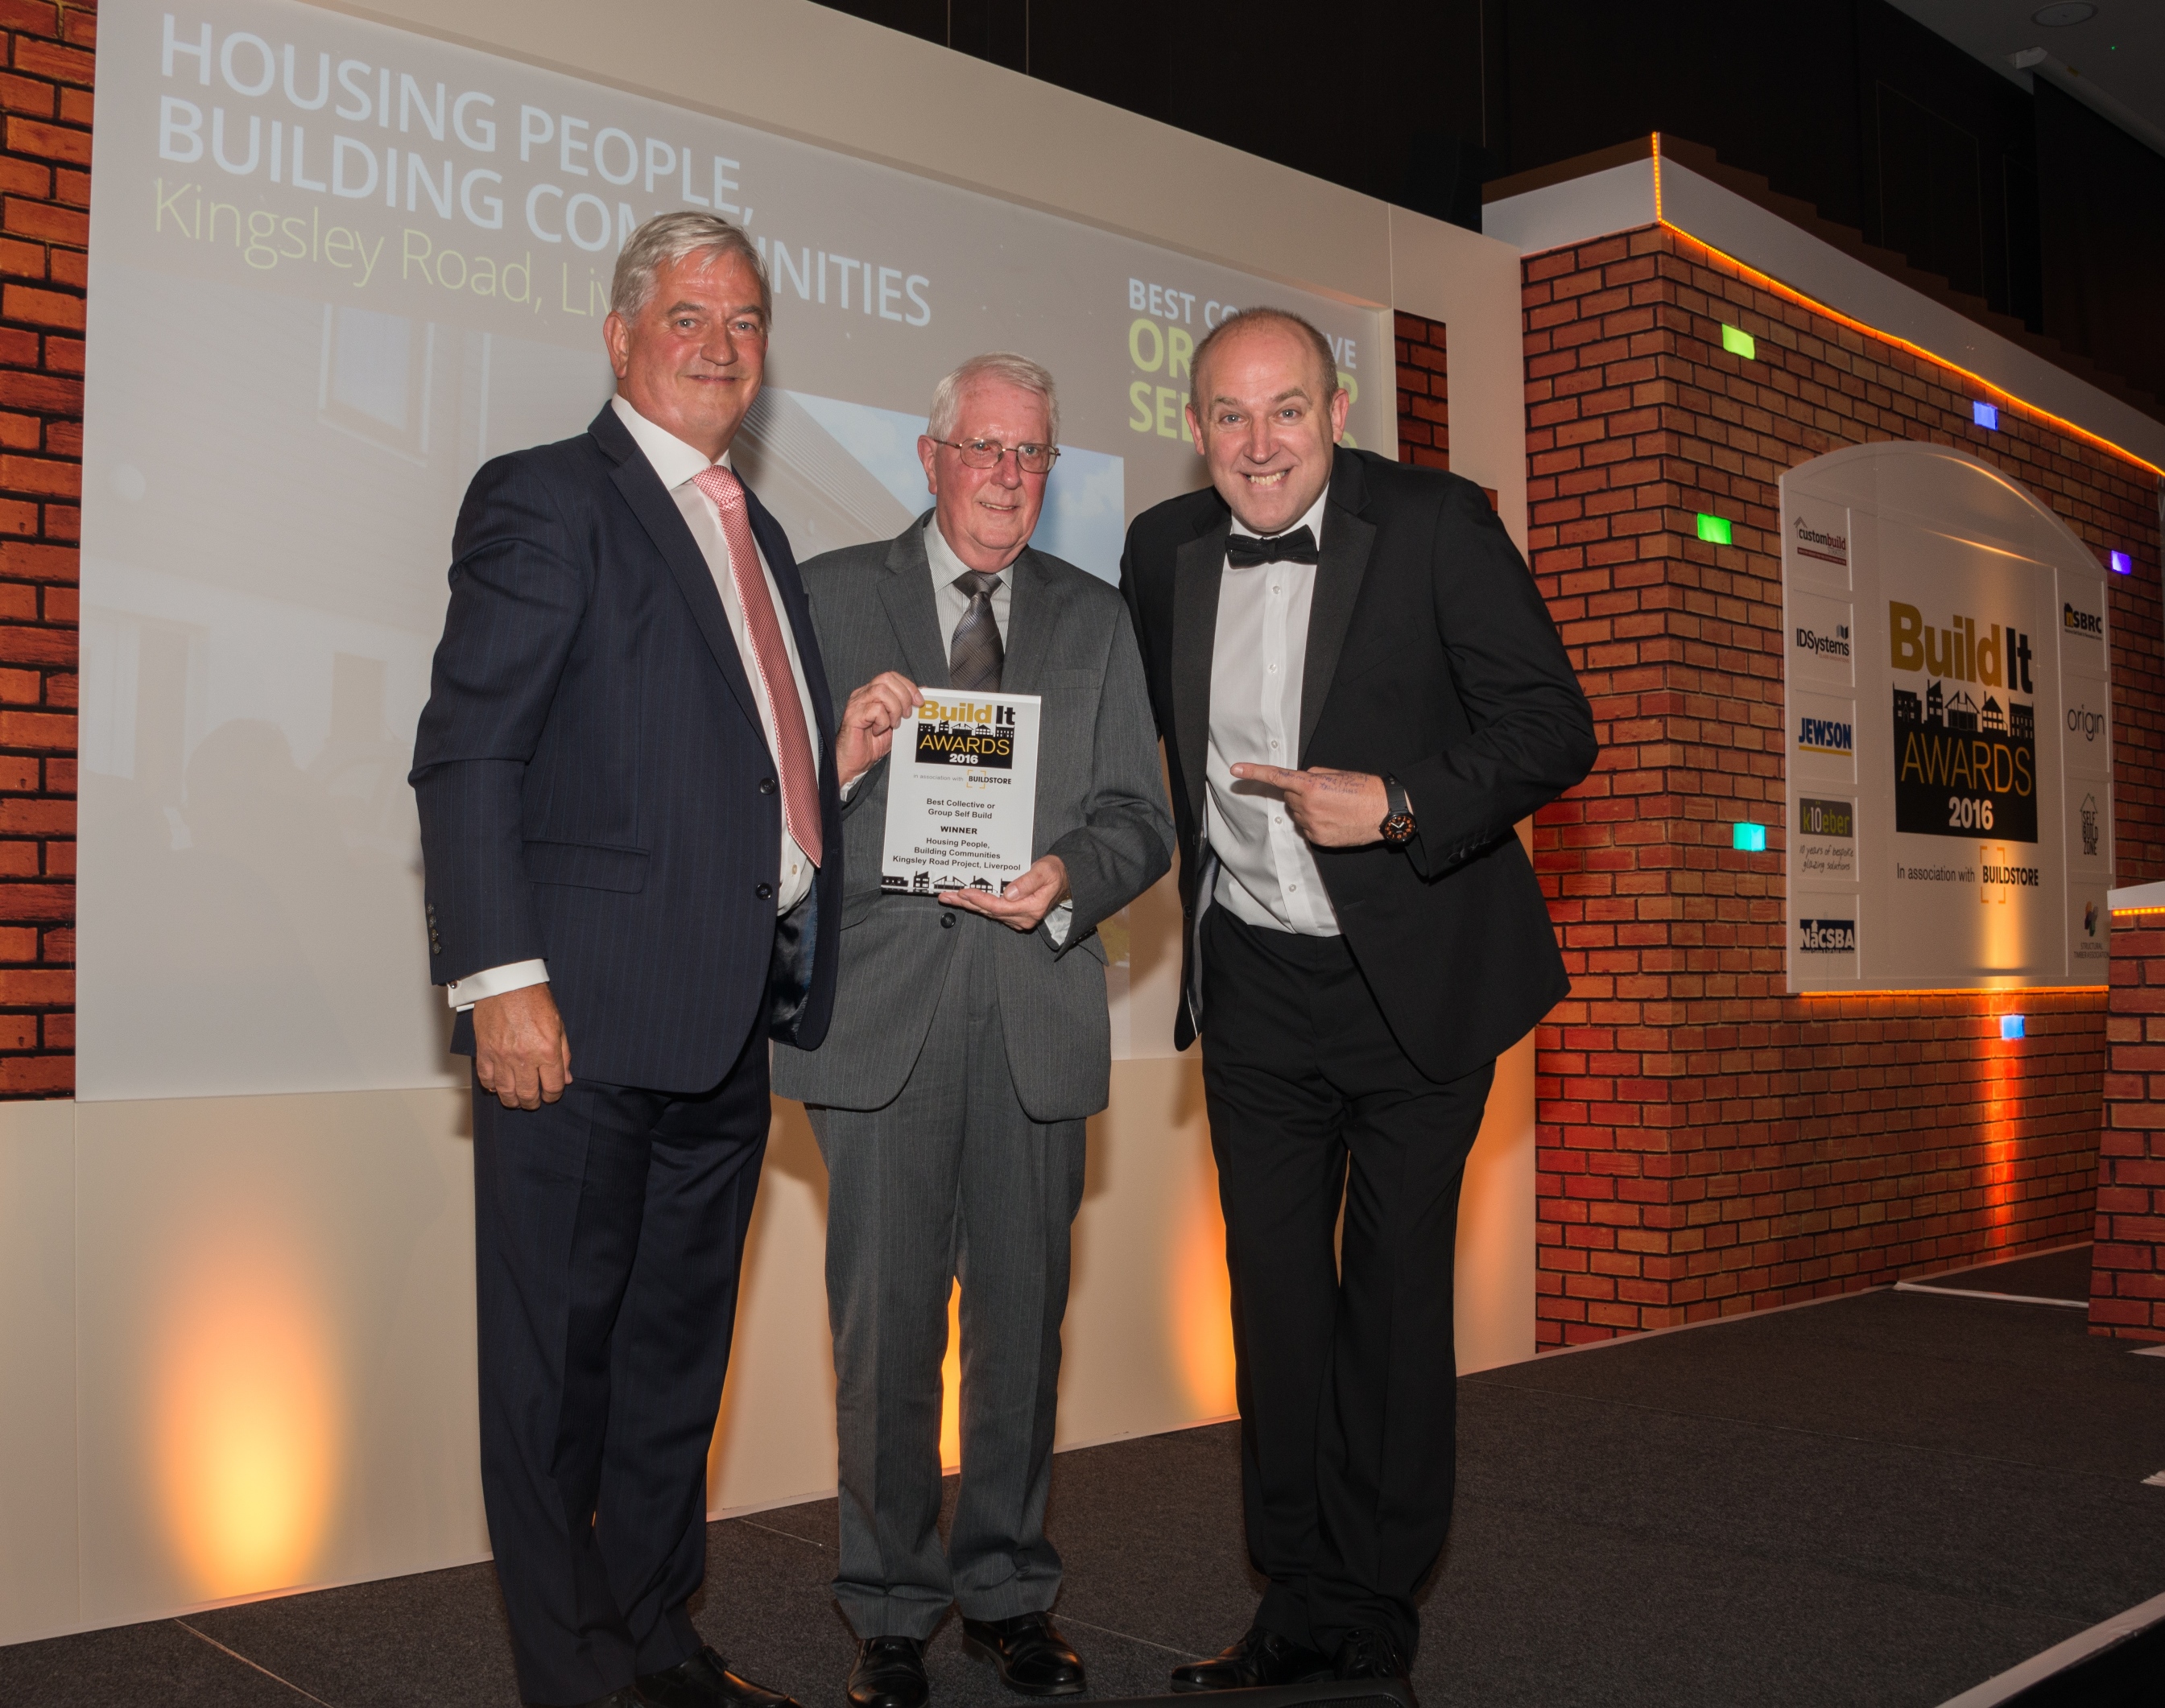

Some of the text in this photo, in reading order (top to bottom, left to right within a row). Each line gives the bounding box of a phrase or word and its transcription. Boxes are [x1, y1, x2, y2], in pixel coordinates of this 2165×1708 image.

[163, 13, 754, 226] HOUSING PEOPLE,
[159, 95, 503, 229] BUILDING
[156, 177, 385, 287] Kingsley
[403, 229, 542, 314] Road,
[1129, 278, 1196, 324] BEST
[1799, 528, 1846, 550] custombuild
[1889, 600, 2033, 694] Build It
[919, 699, 1015, 725] Build It
[2068, 704, 2105, 741] origin
[919, 734, 1010, 755] AWARDS
[1799, 717, 1852, 749] JEWSON
[949, 753, 978, 764] 2016
[1901, 731, 2031, 796] AWARDS
[969, 776, 1011, 784] BUILDSTORE
[928, 809, 952, 817] Group
[947, 800, 985, 809] Collective
[1948, 796, 1994, 831] 2016
[940, 826, 977, 834] WINNER
[914, 847, 1001, 859] Building Communities
[926, 838, 990, 849] Housing People,
[1806, 847, 1823, 859] years
[893, 856, 926, 865] Kingsley
[952, 859, 981, 868] Project,
[984, 862, 1021, 871] Liverpool
[1897, 862, 2039, 886] In association with BUILDSTORE
